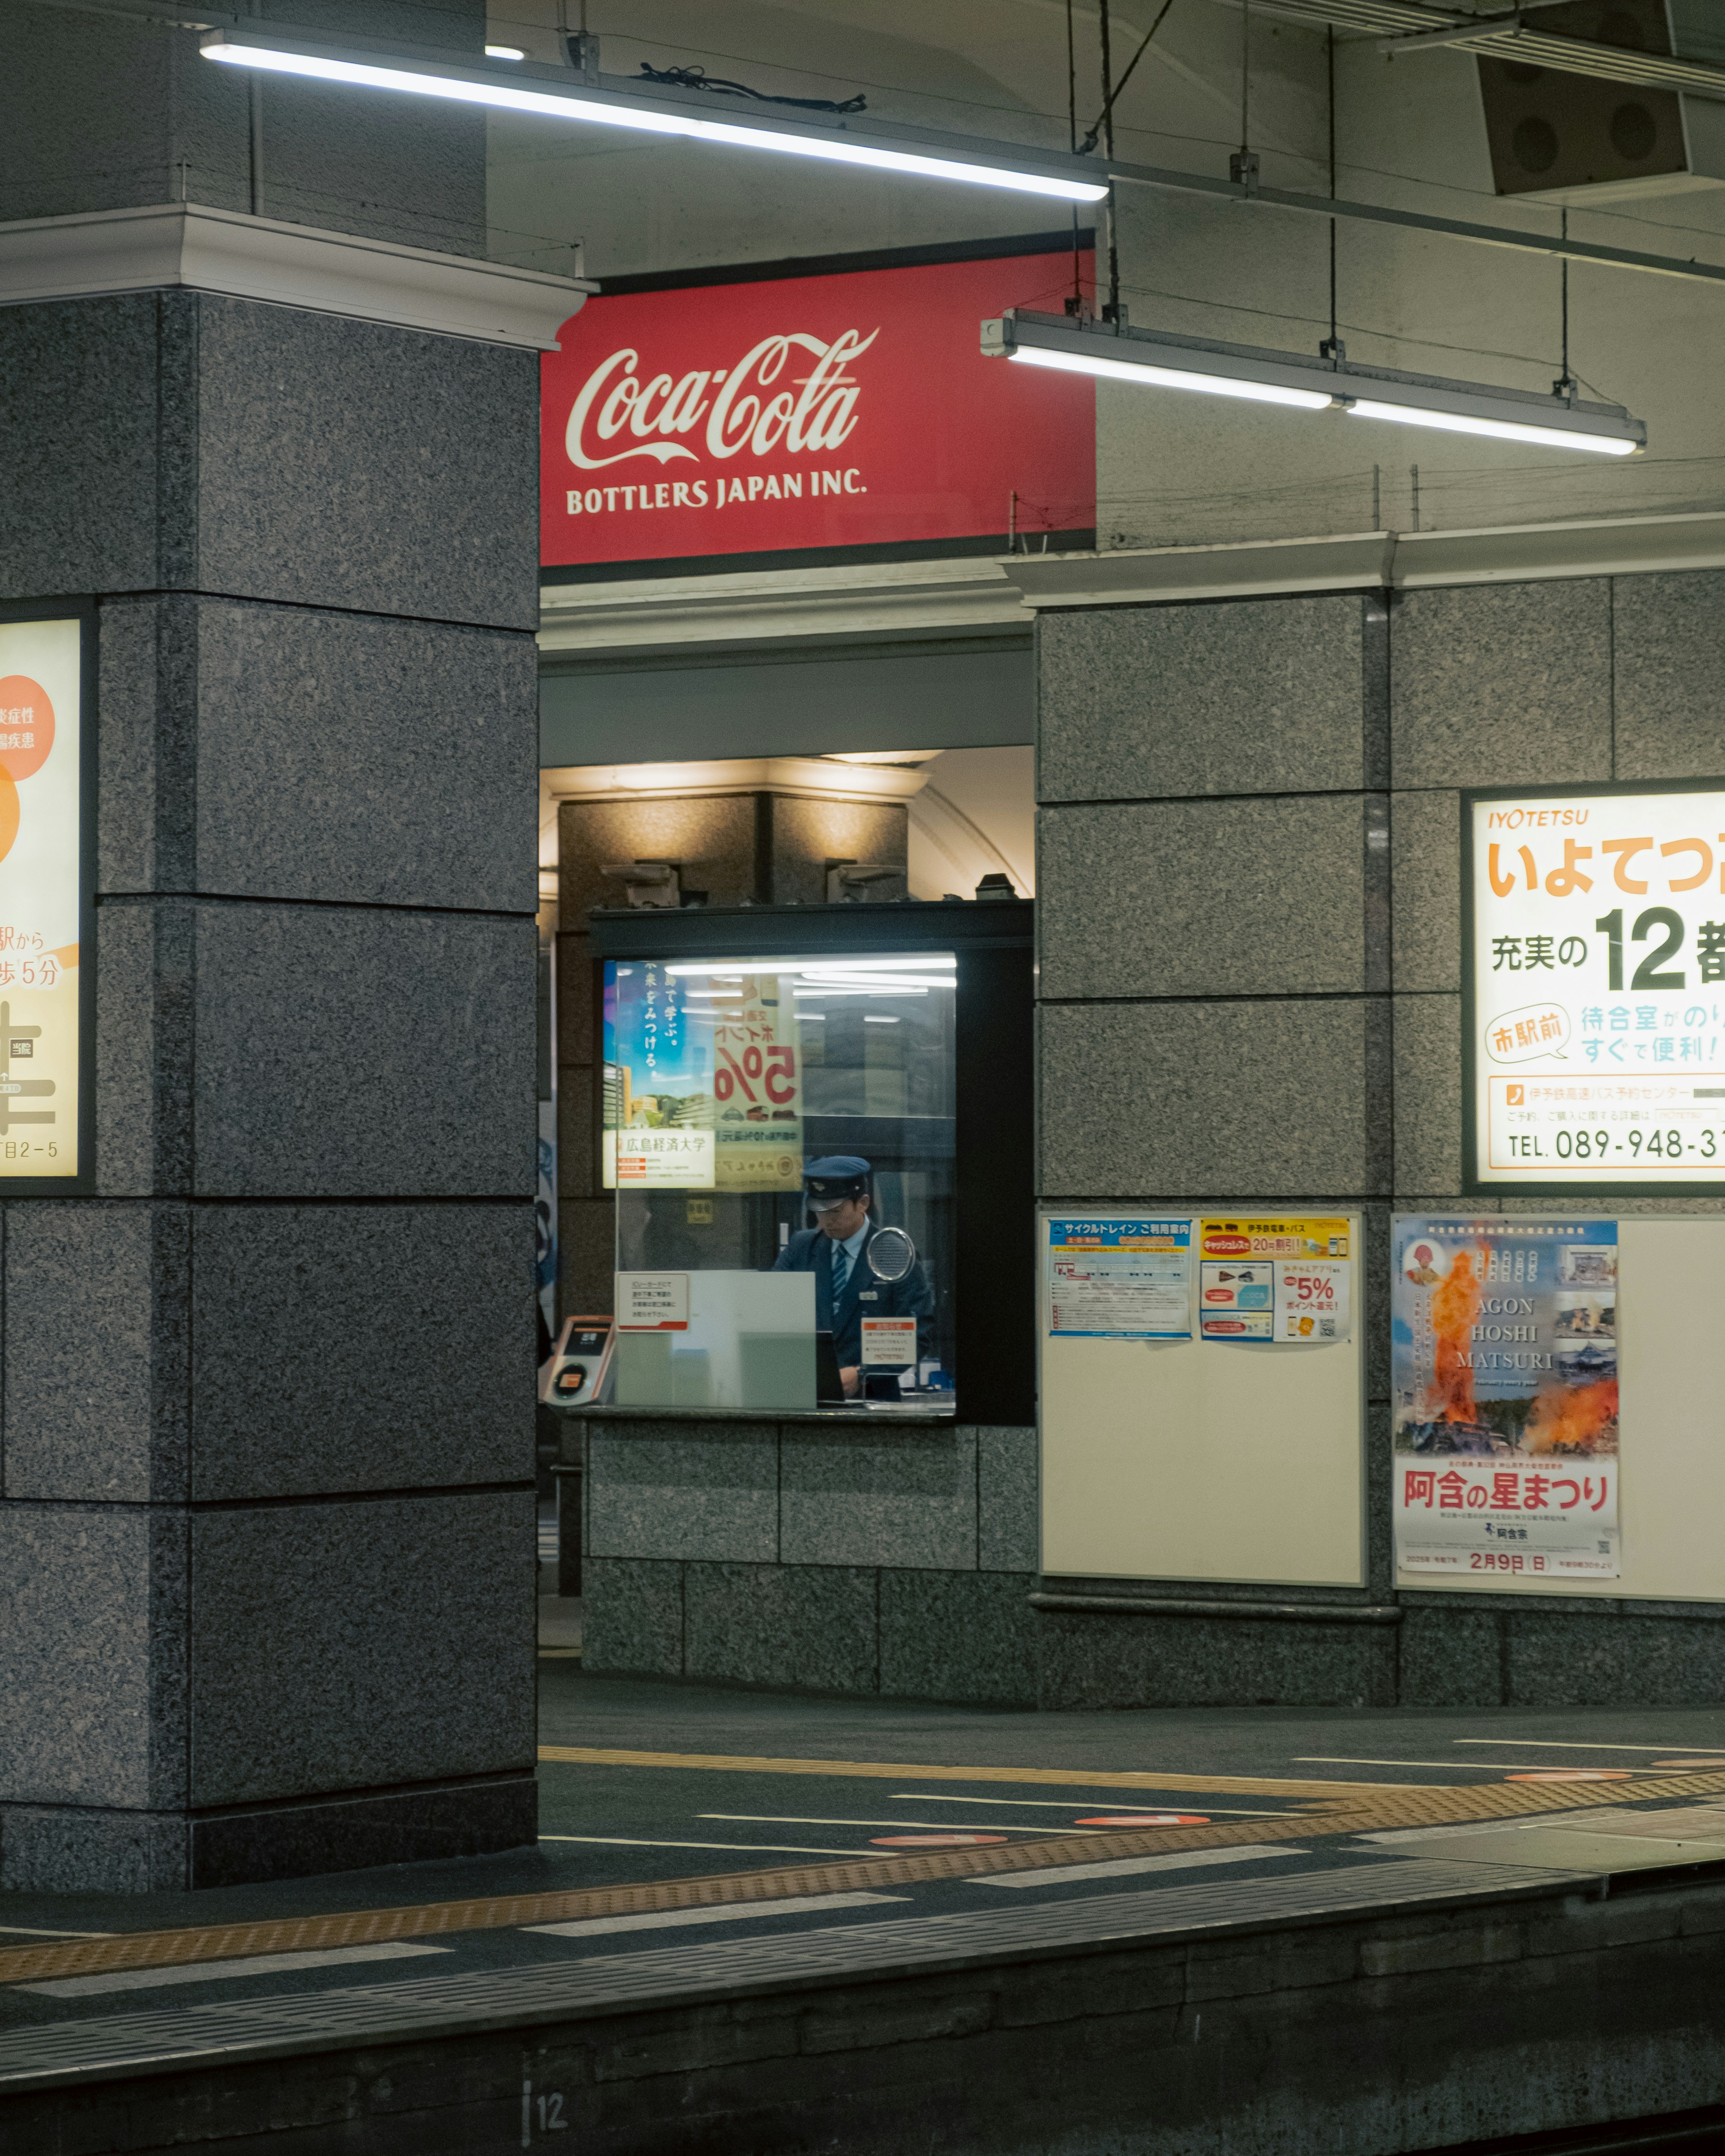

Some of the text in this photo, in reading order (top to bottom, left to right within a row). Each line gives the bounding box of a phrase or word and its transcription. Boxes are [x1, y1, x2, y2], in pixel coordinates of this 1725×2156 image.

[566, 327, 880, 469] Coca-Cola
[566, 468, 867, 515] BOTTLERS JAPAN INC.
[1488, 809, 1589, 829] IYOTETSU
[1488, 833, 1725, 897] いよてつ
[1492, 1012, 1563, 1053] 市駅前
[1530, 1087, 1690, 1101] 伊予鉄高速バス予約センター
[626, 1137, 706, 1152] 広島経済大学
[1509, 1129, 1725, 1159] TEL. 089-948-3
[1298, 1277, 1334, 1300] 5%
[1475, 1298, 1535, 1314] AGON
[1471, 1326, 1538, 1342] HOSHI
[1456, 1352, 1554, 1369] MATSURI
[1404, 1470, 1607, 1511] 阿含の星まつり
[1497, 1528, 1528, 1539] 阿含宗
